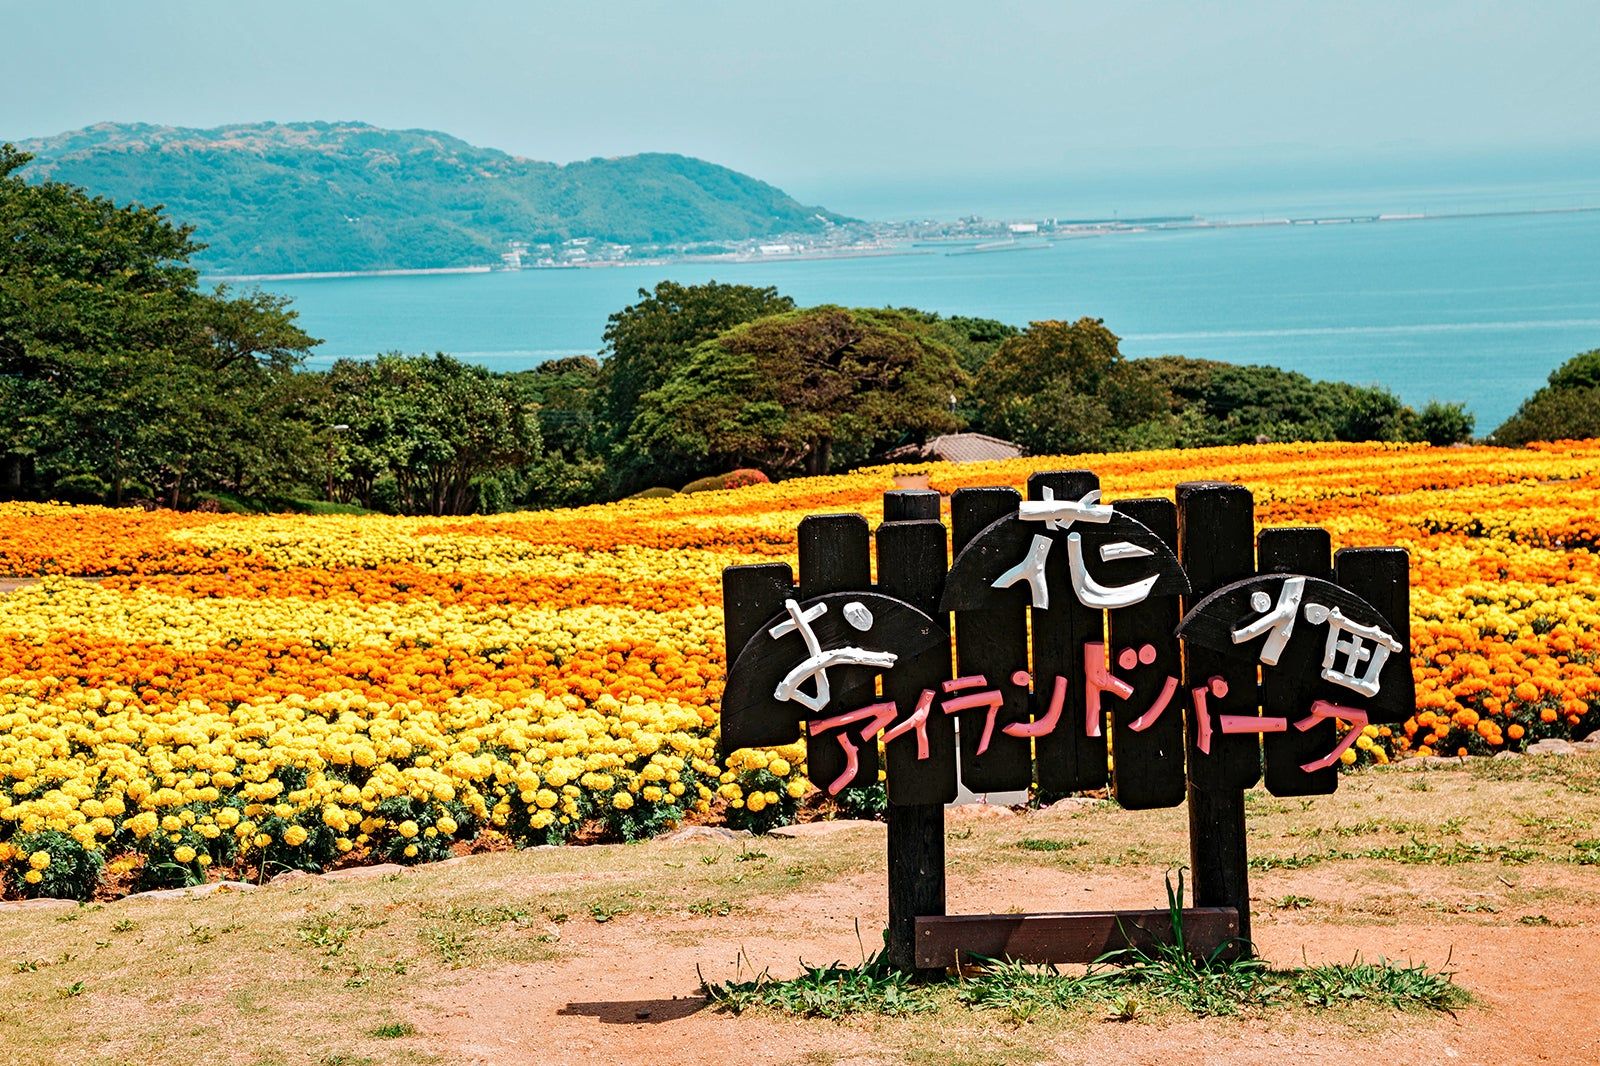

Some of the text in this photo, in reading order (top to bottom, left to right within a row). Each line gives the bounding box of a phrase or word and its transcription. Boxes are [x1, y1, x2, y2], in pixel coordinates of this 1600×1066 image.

[808, 641, 1369, 796] アイランドパーク
